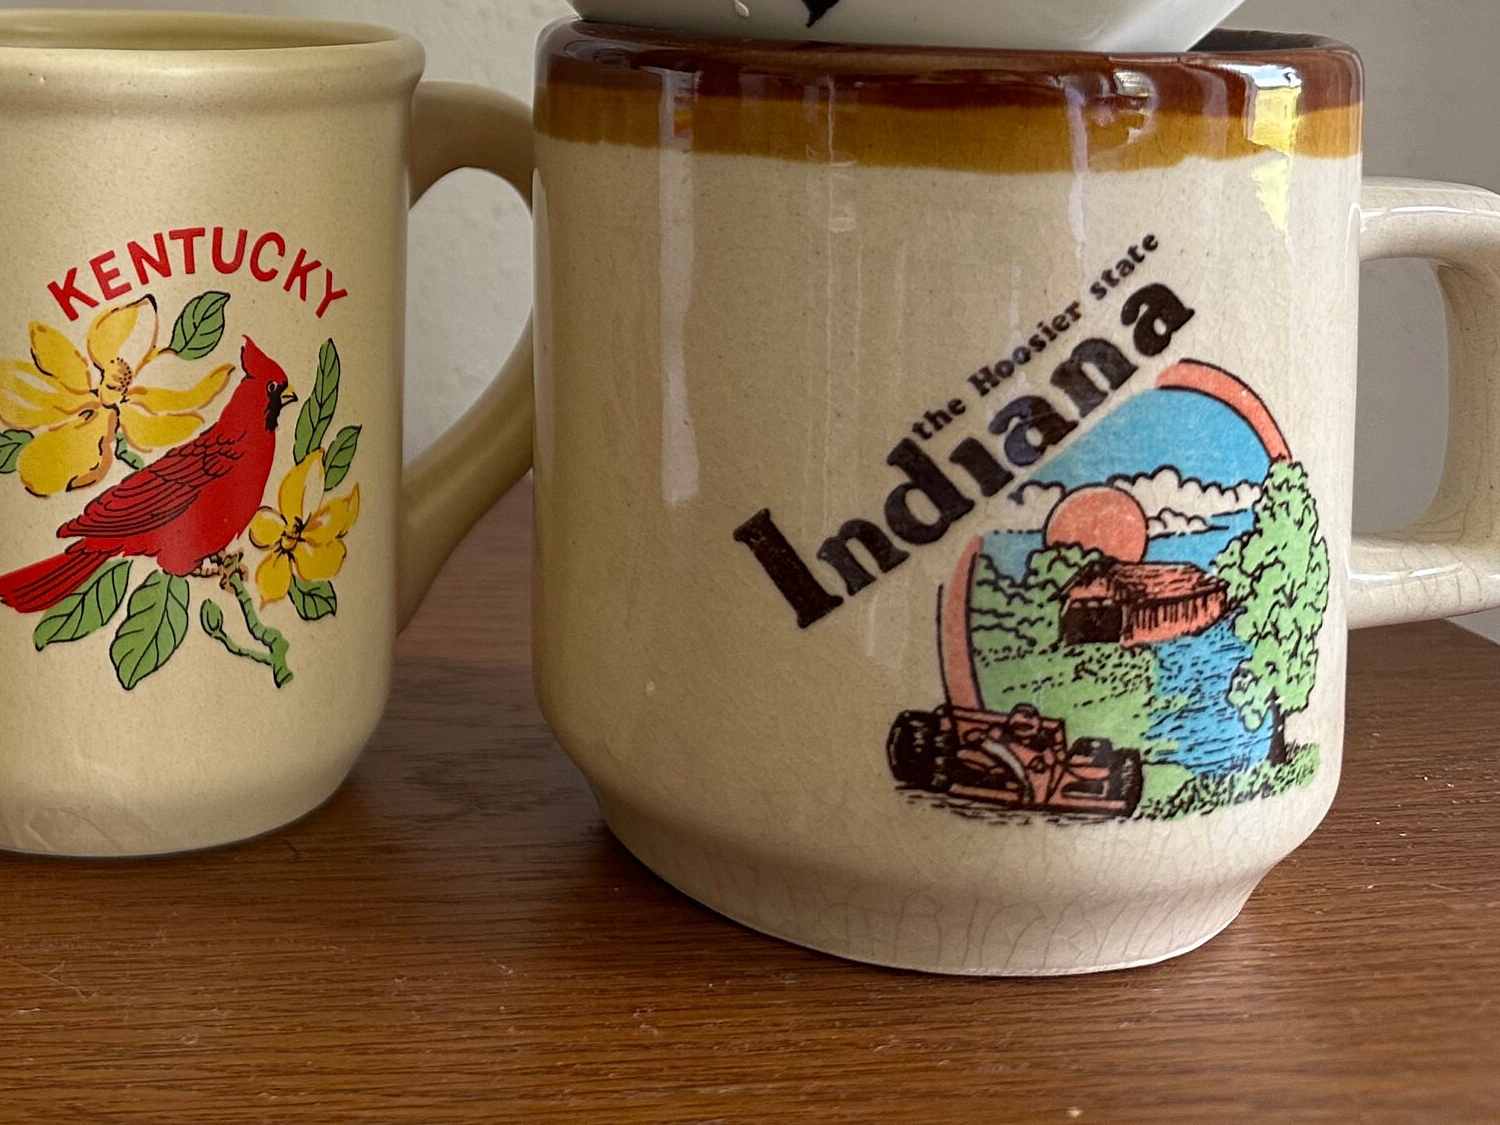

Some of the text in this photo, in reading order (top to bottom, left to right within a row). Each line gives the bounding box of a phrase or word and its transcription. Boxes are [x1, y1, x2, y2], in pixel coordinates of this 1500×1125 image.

[47, 226, 348, 321] KENTUCKY
[911, 231, 1159, 442] the Hoosier state
[732, 282, 1196, 630] Indiana
